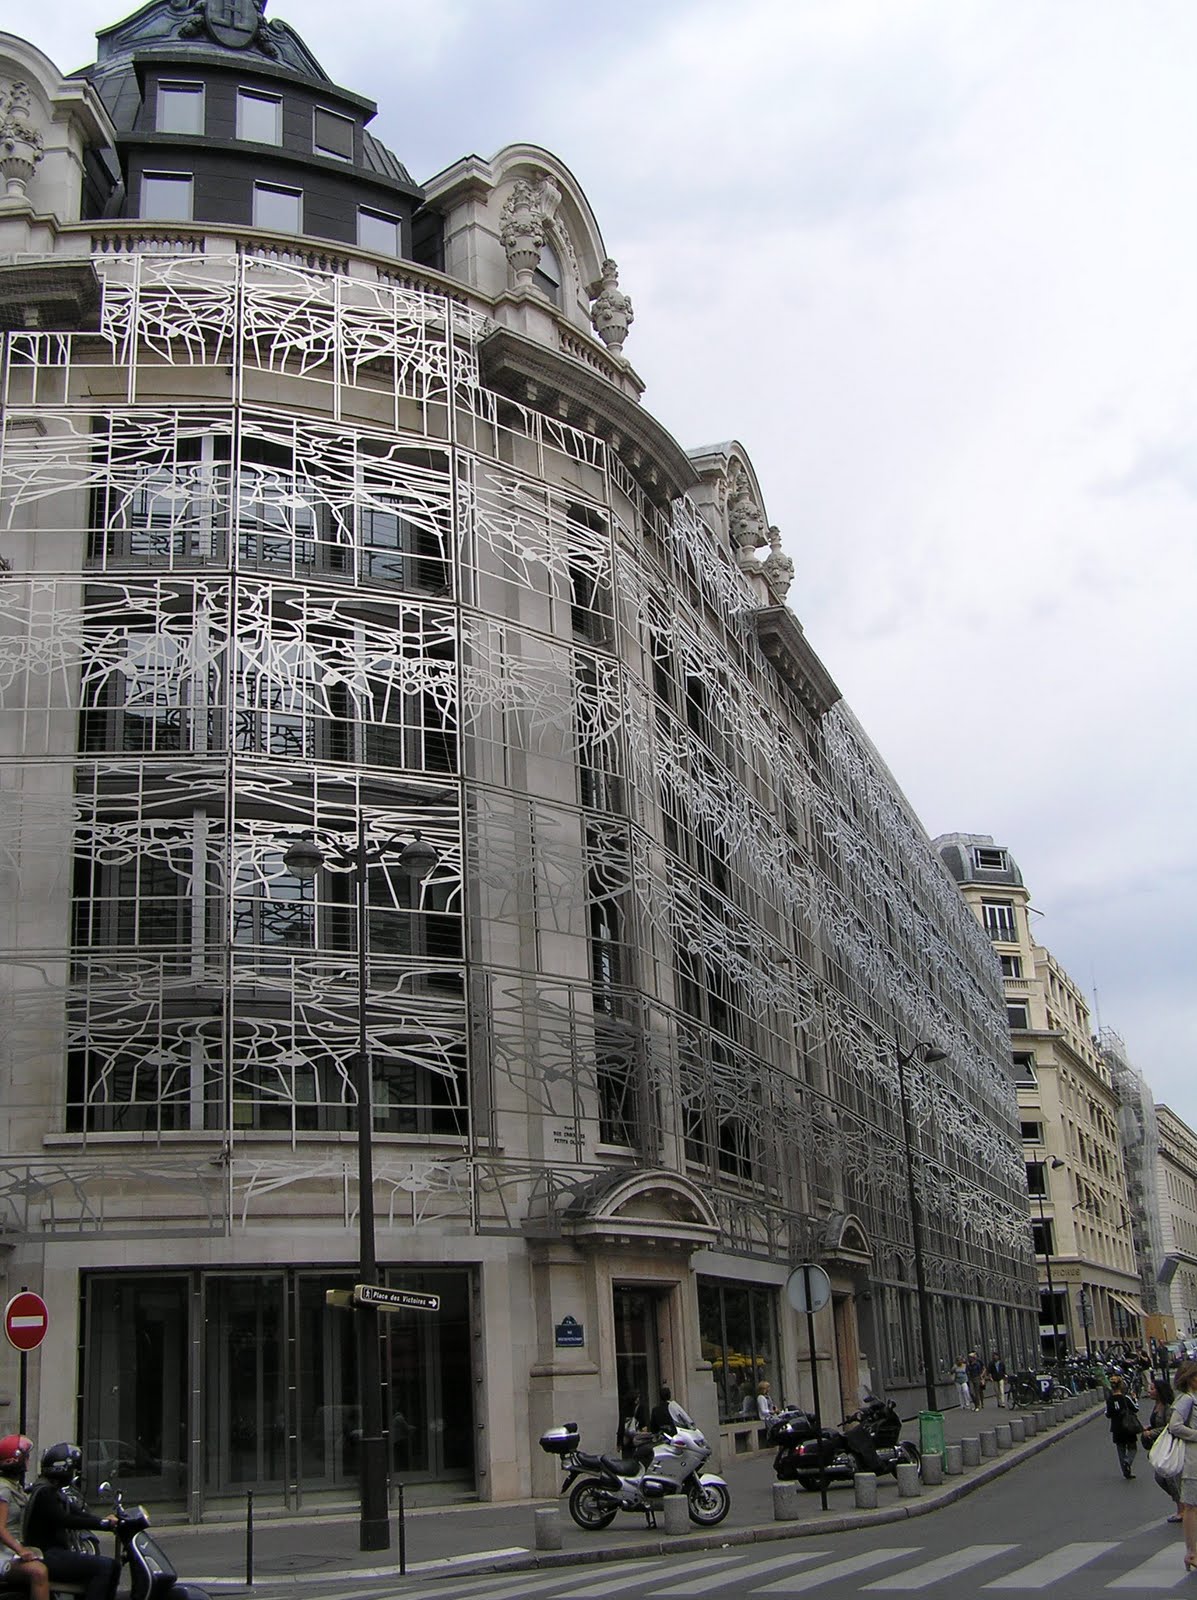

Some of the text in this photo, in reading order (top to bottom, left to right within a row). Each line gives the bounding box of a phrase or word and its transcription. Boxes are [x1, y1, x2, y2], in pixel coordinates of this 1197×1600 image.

[373, 1291, 426, 1306] Place des Victoires
[1040, 1380, 1050, 1393] P
